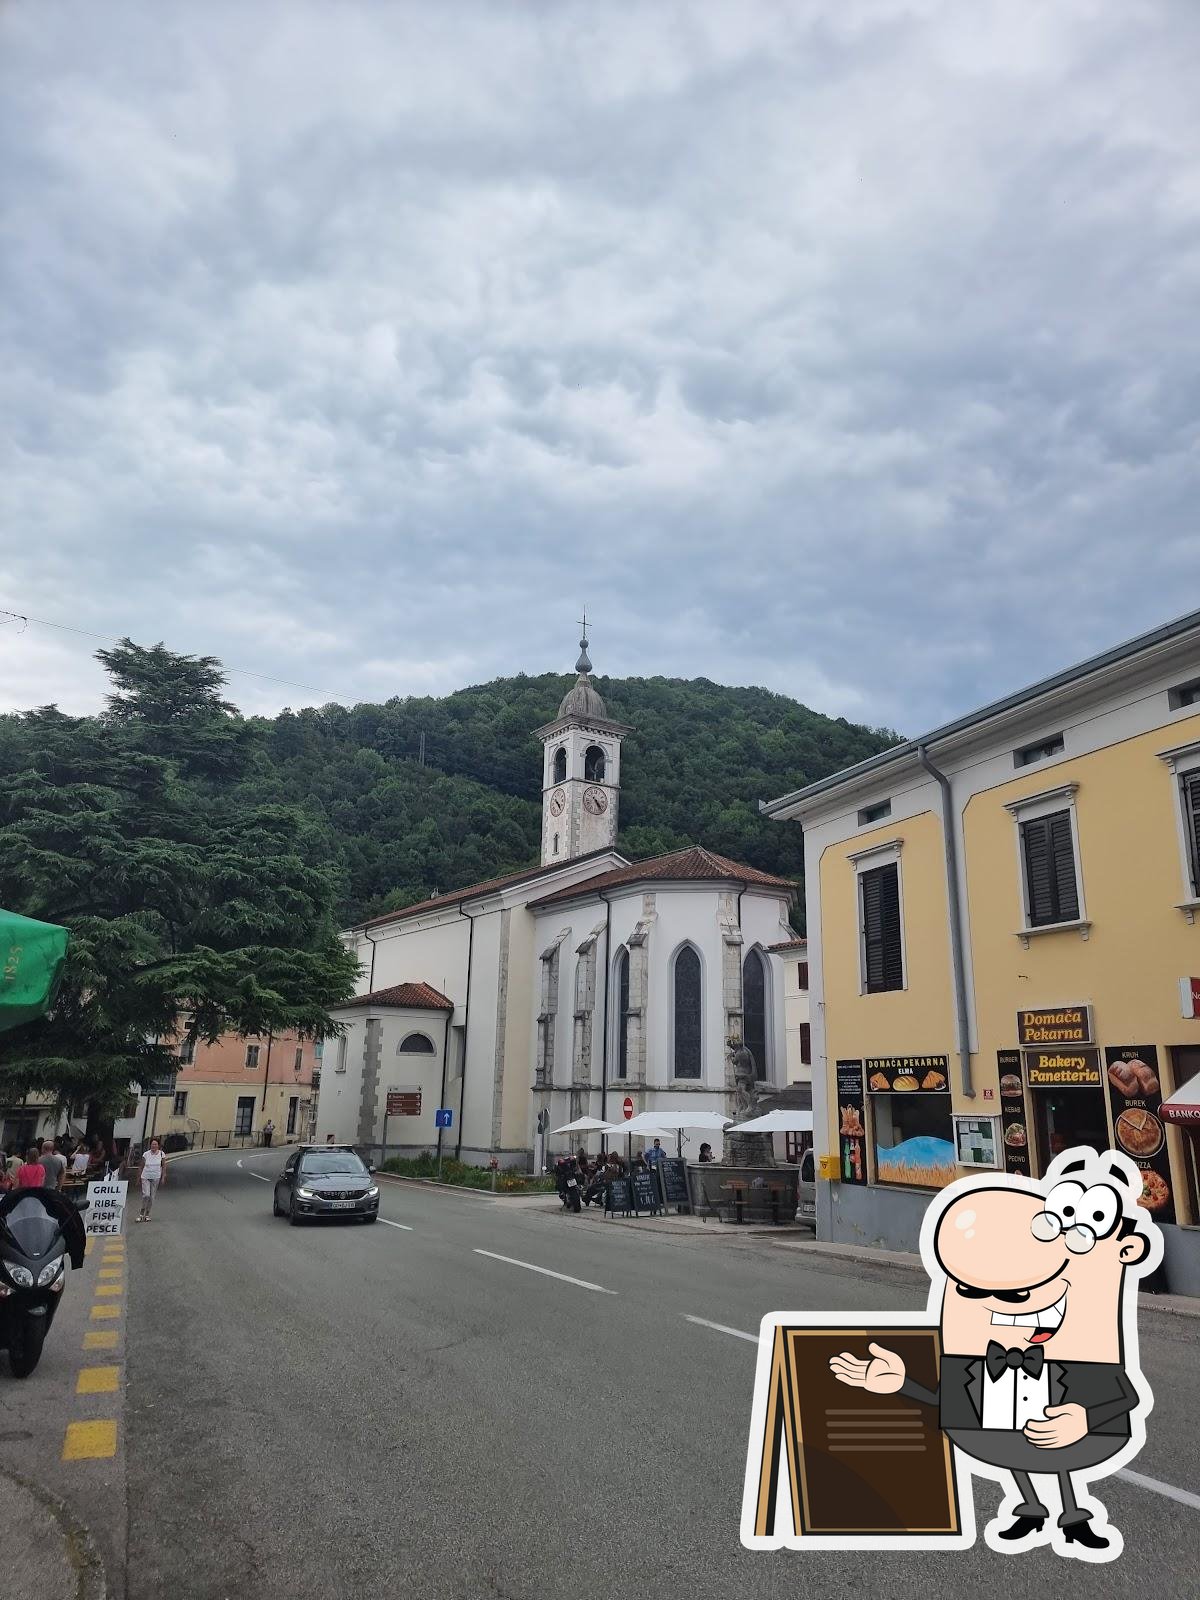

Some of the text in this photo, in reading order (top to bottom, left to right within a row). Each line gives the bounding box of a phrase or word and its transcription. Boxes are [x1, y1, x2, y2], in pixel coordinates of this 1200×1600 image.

[1023, 1009, 1081, 1026] Domača
[1024, 1027, 1083, 1041] Pekarna
[1121, 1051, 1139, 1059] KRUH
[868, 1057, 945, 1068] DOMAČA PEKARNA
[999, 1056, 1018, 1064] BURGER
[1039, 1055, 1086, 1068] Bakery
[1029, 1069, 1099, 1083] Panetteria
[1124, 1100, 1146, 1108] BUREK
[93, 1186, 121, 1194] GRILL
[94, 1200, 117, 1208] RIBE
[92, 1212, 115, 1221] FISH
[86, 1225, 118, 1233] PESCE
